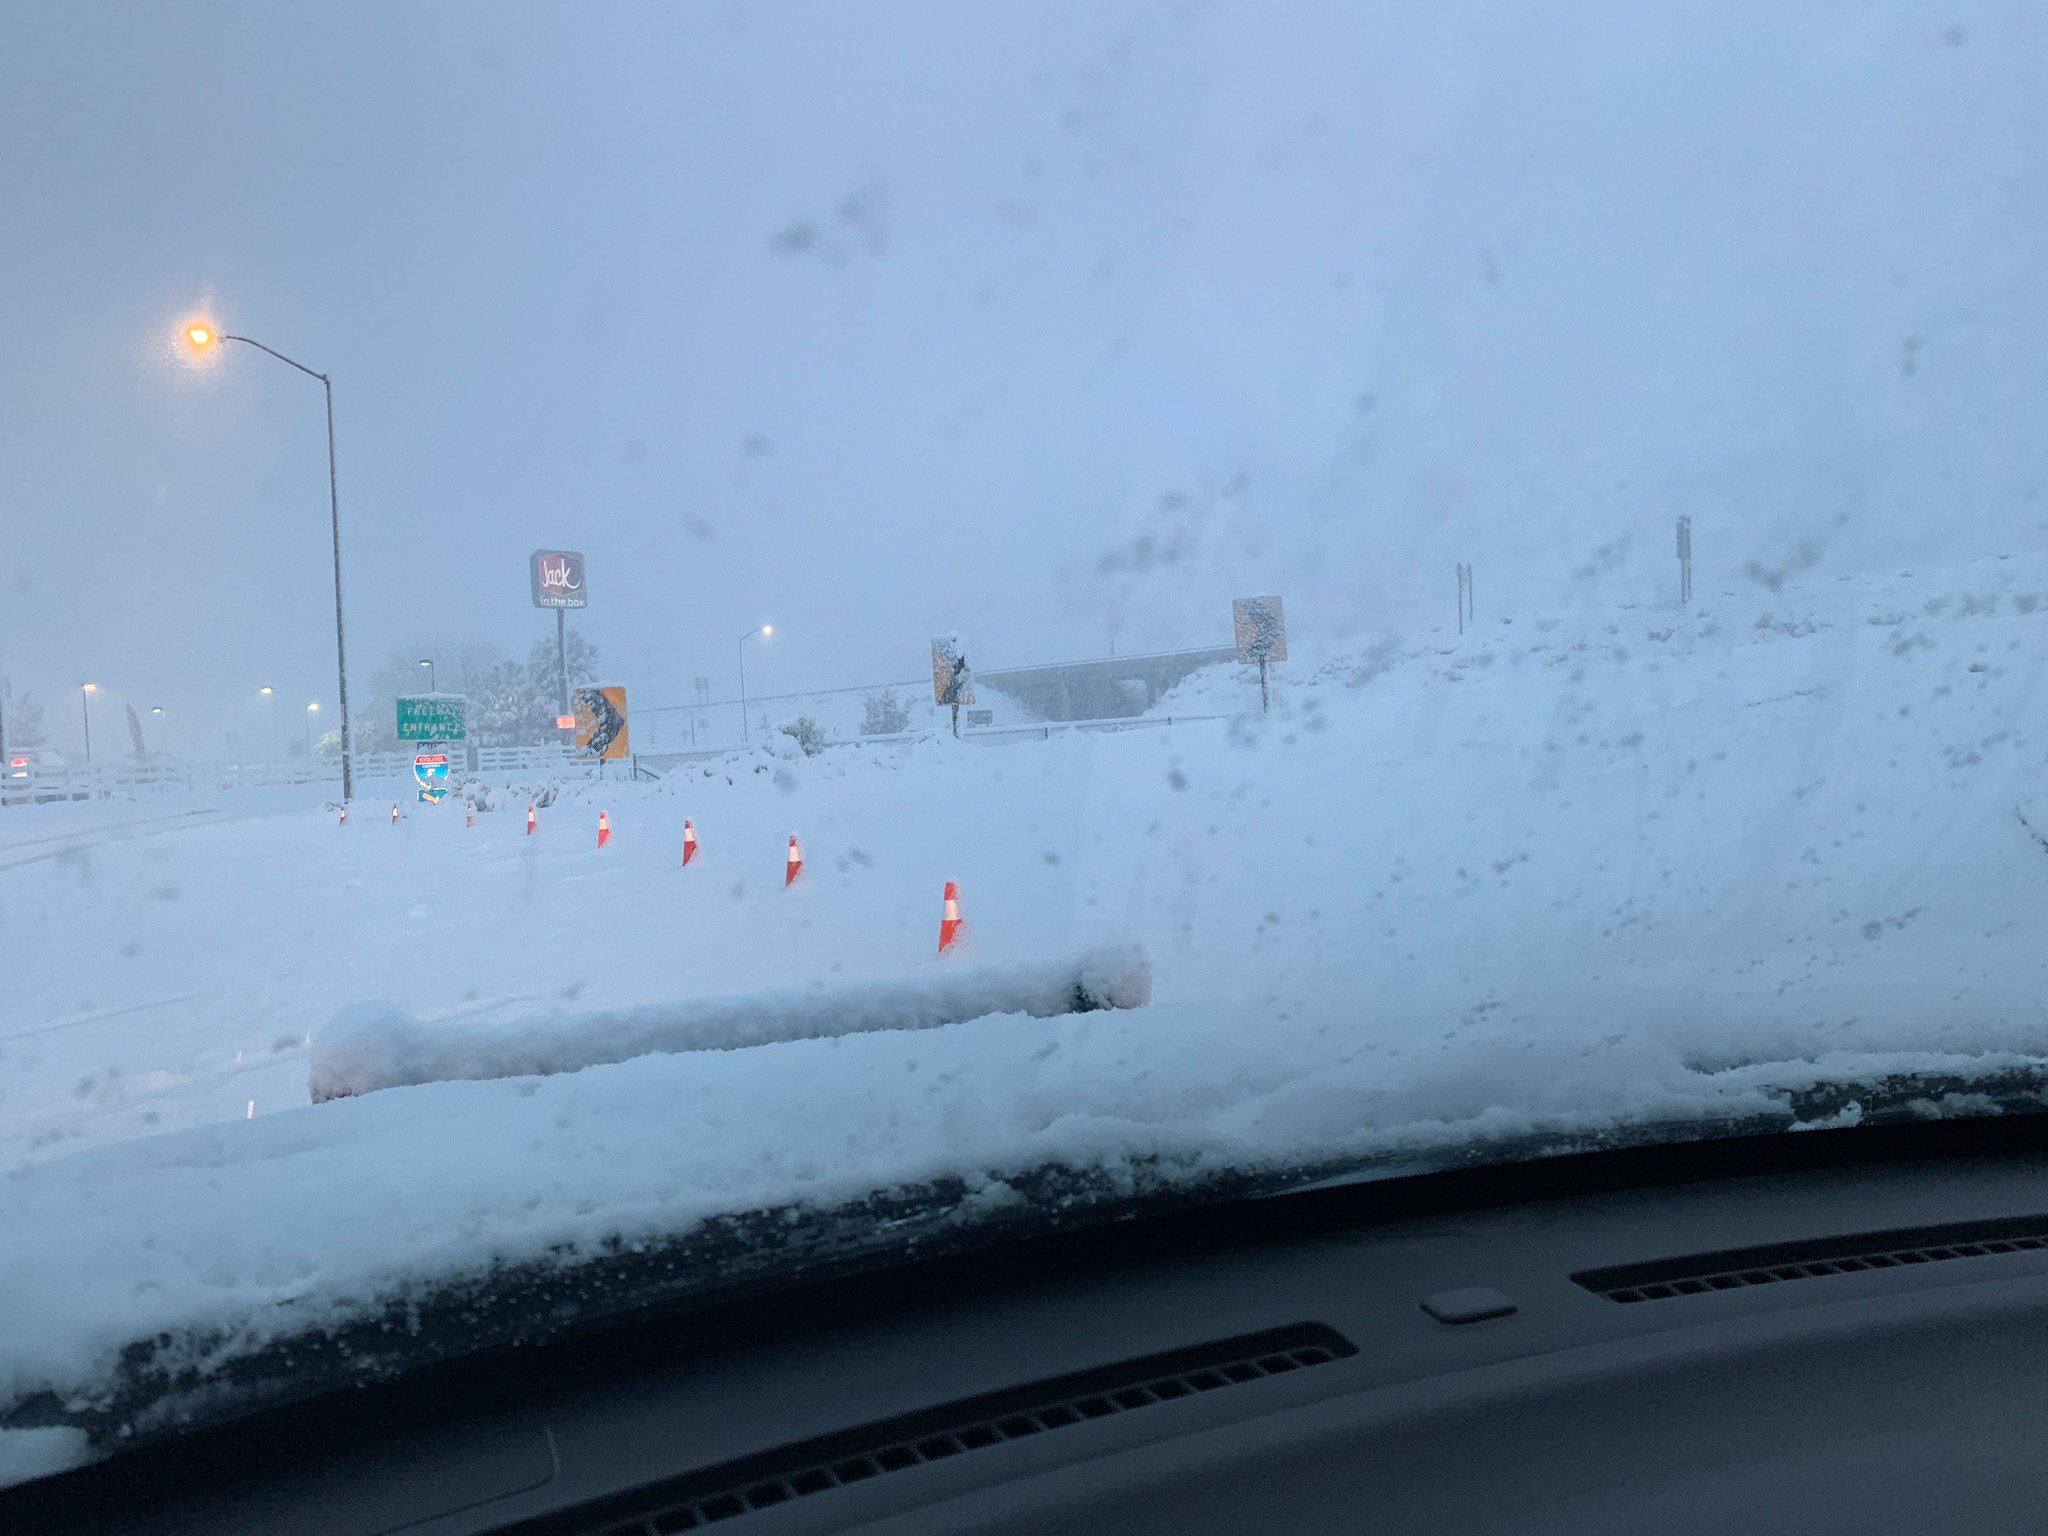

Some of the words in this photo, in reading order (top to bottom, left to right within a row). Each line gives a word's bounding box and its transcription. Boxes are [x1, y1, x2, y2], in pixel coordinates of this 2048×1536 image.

[541, 558, 581, 589] Jack
[551, 597, 566, 606] the
[568, 597, 585, 606] box
[407, 704, 459, 716] FREEW
